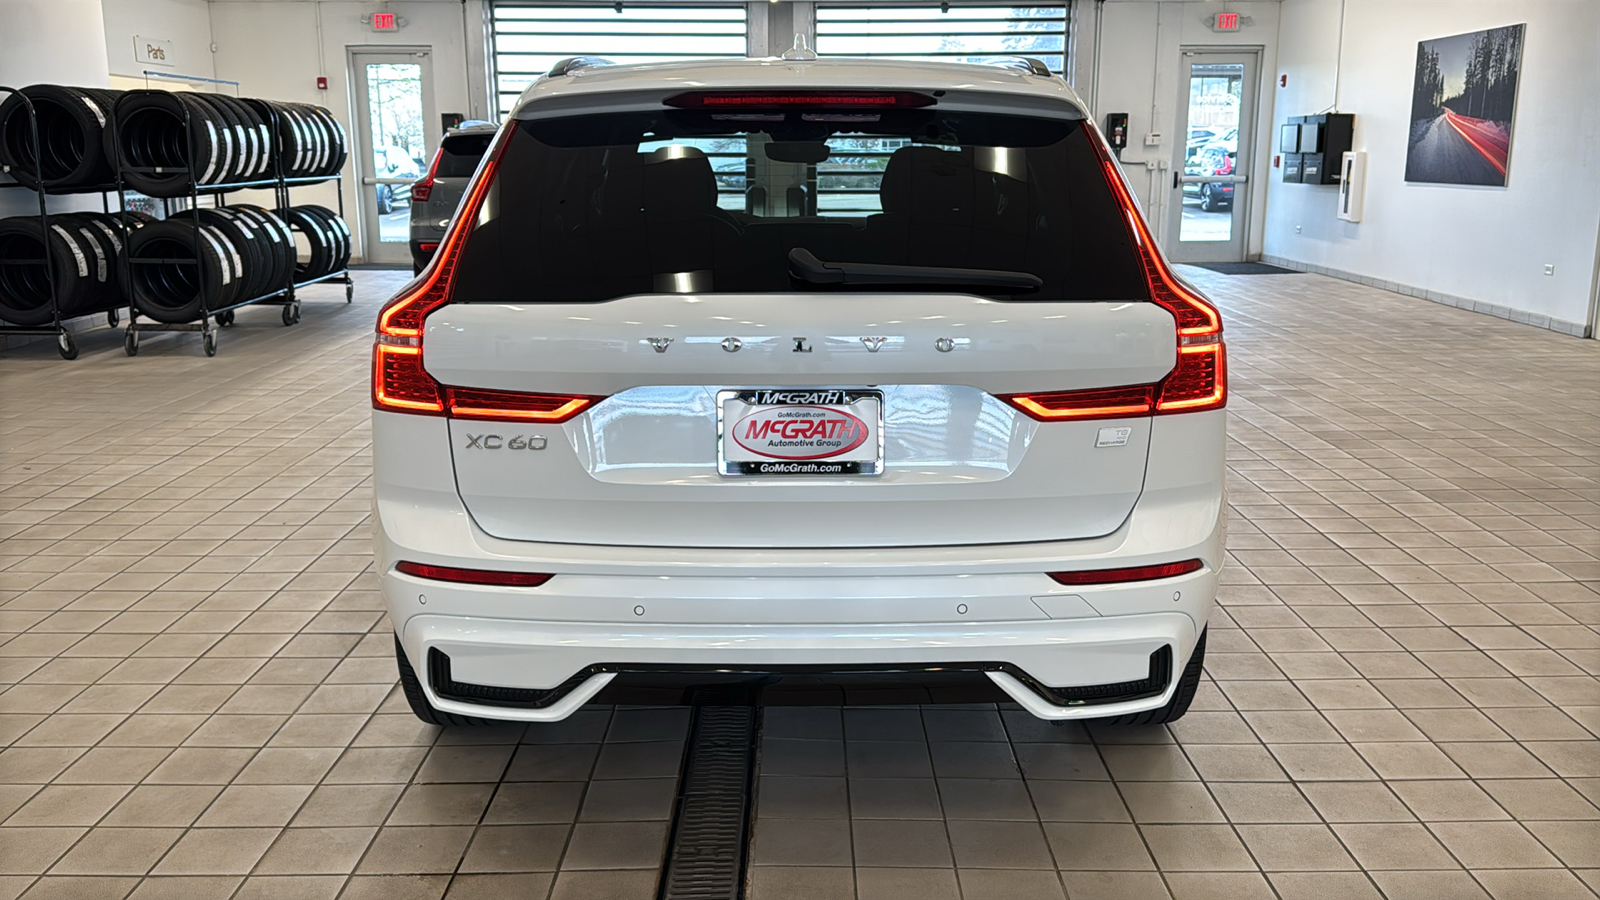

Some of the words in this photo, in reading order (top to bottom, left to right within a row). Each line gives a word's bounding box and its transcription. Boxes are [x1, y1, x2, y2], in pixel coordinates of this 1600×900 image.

[374, 13, 394, 29] EXIT
[1218, 13, 1238, 29] EXIT
[146, 43, 166, 61] Parts
[767, 439, 815, 447] Automotive
[816, 439, 842, 448] Group
[760, 463, 842, 473] GoMcGrath.com
